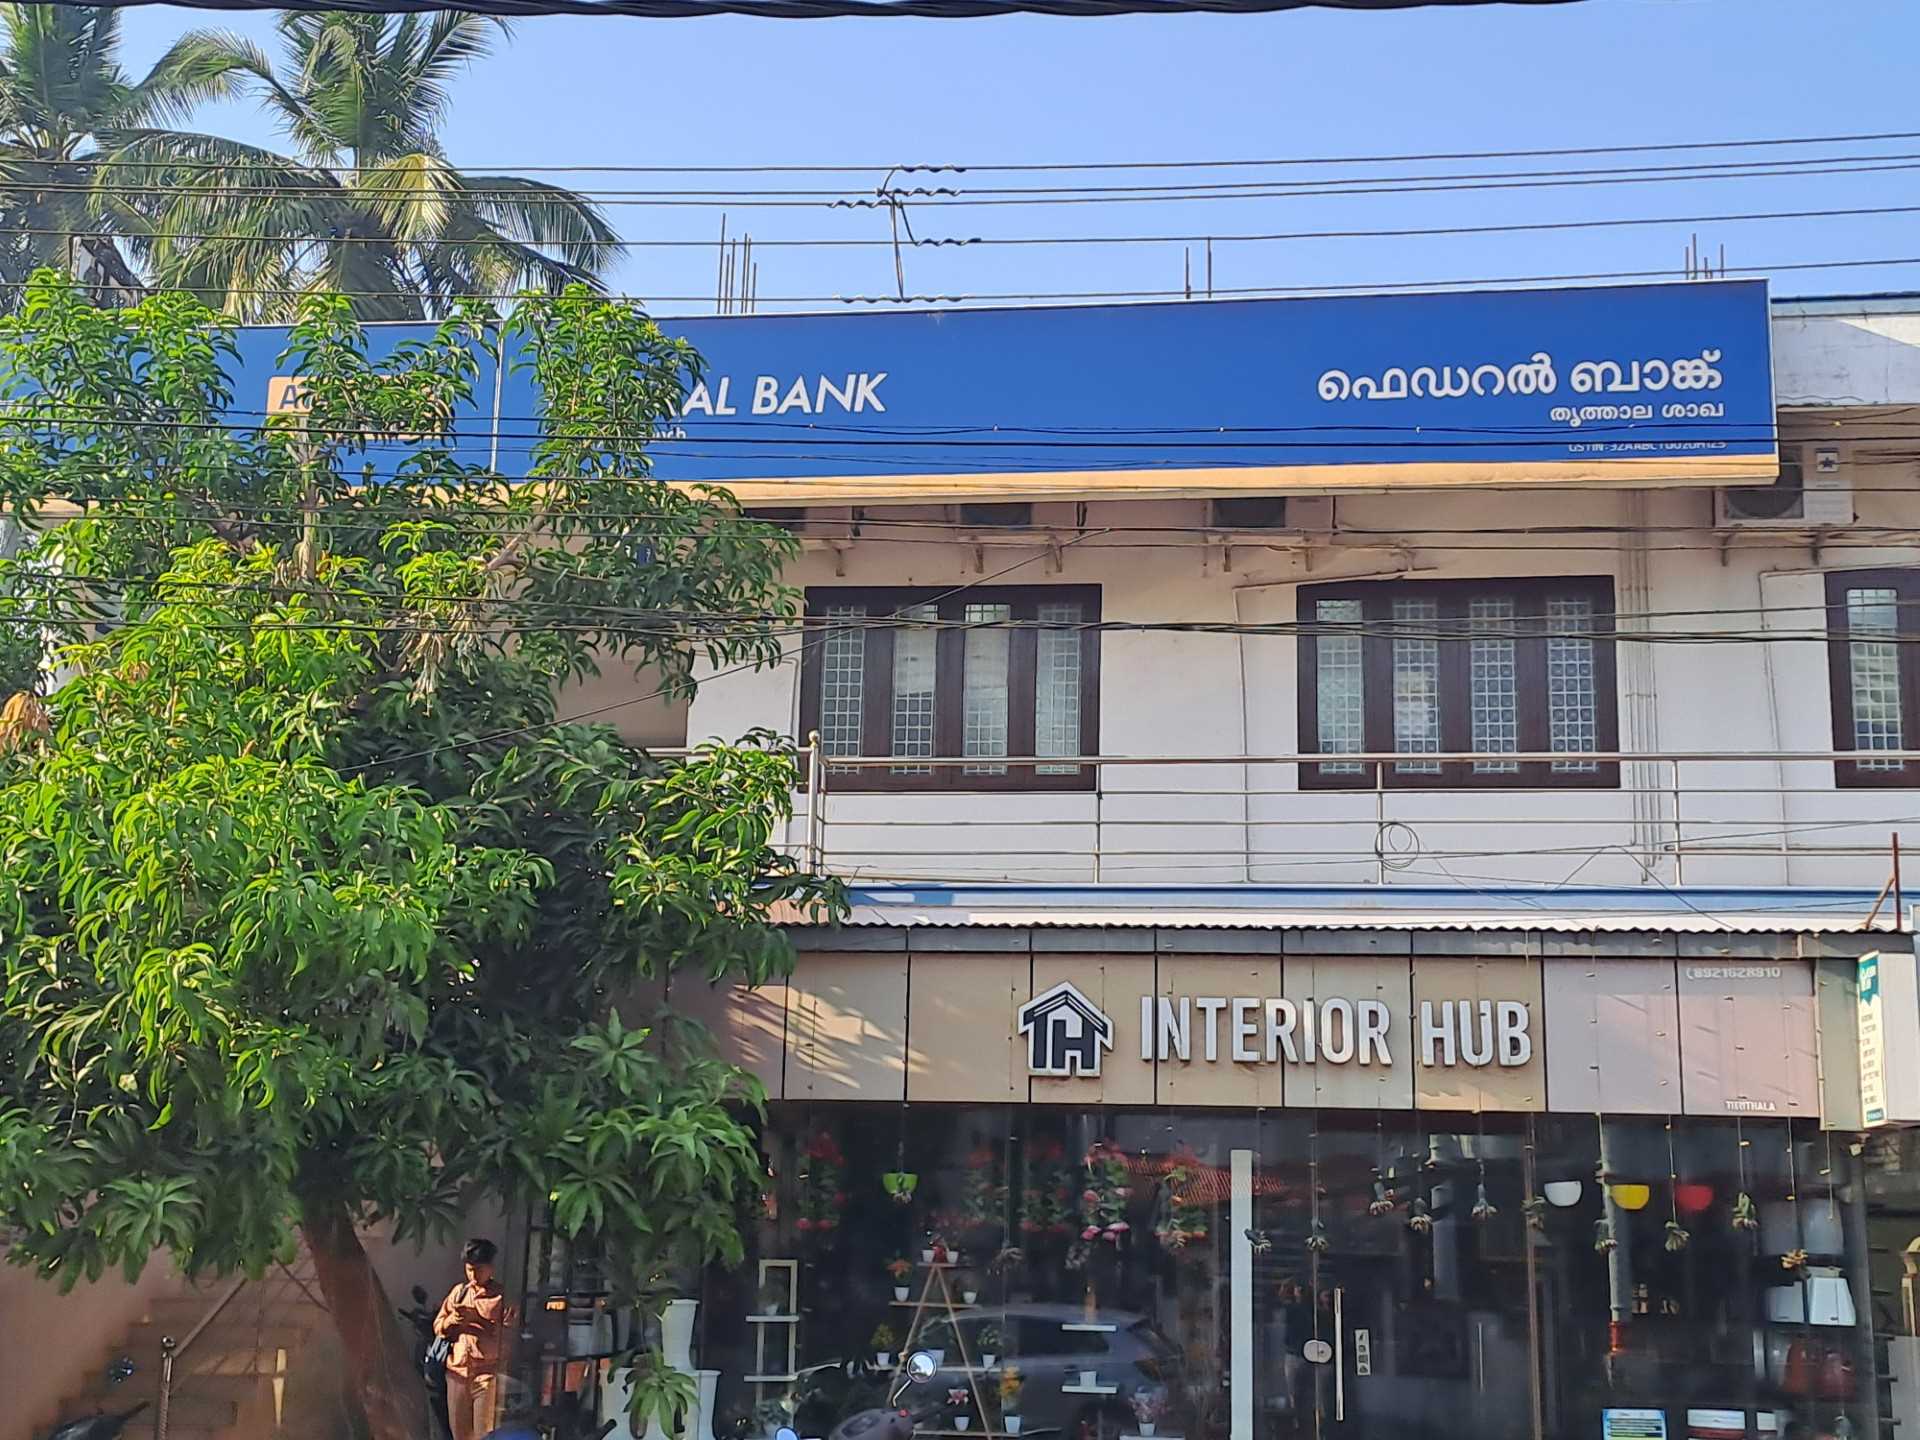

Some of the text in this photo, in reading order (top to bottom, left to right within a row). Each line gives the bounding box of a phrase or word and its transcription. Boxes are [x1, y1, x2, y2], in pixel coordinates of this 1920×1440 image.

[751, 372, 888, 416] BANK
[1317, 348, 1723, 401] ഫെഡറൽ ബാങ്ക്
[1550, 402, 1724, 427] തൃത്താല ശാഖ
[1140, 995, 1532, 1067] INTERIOR HUB
